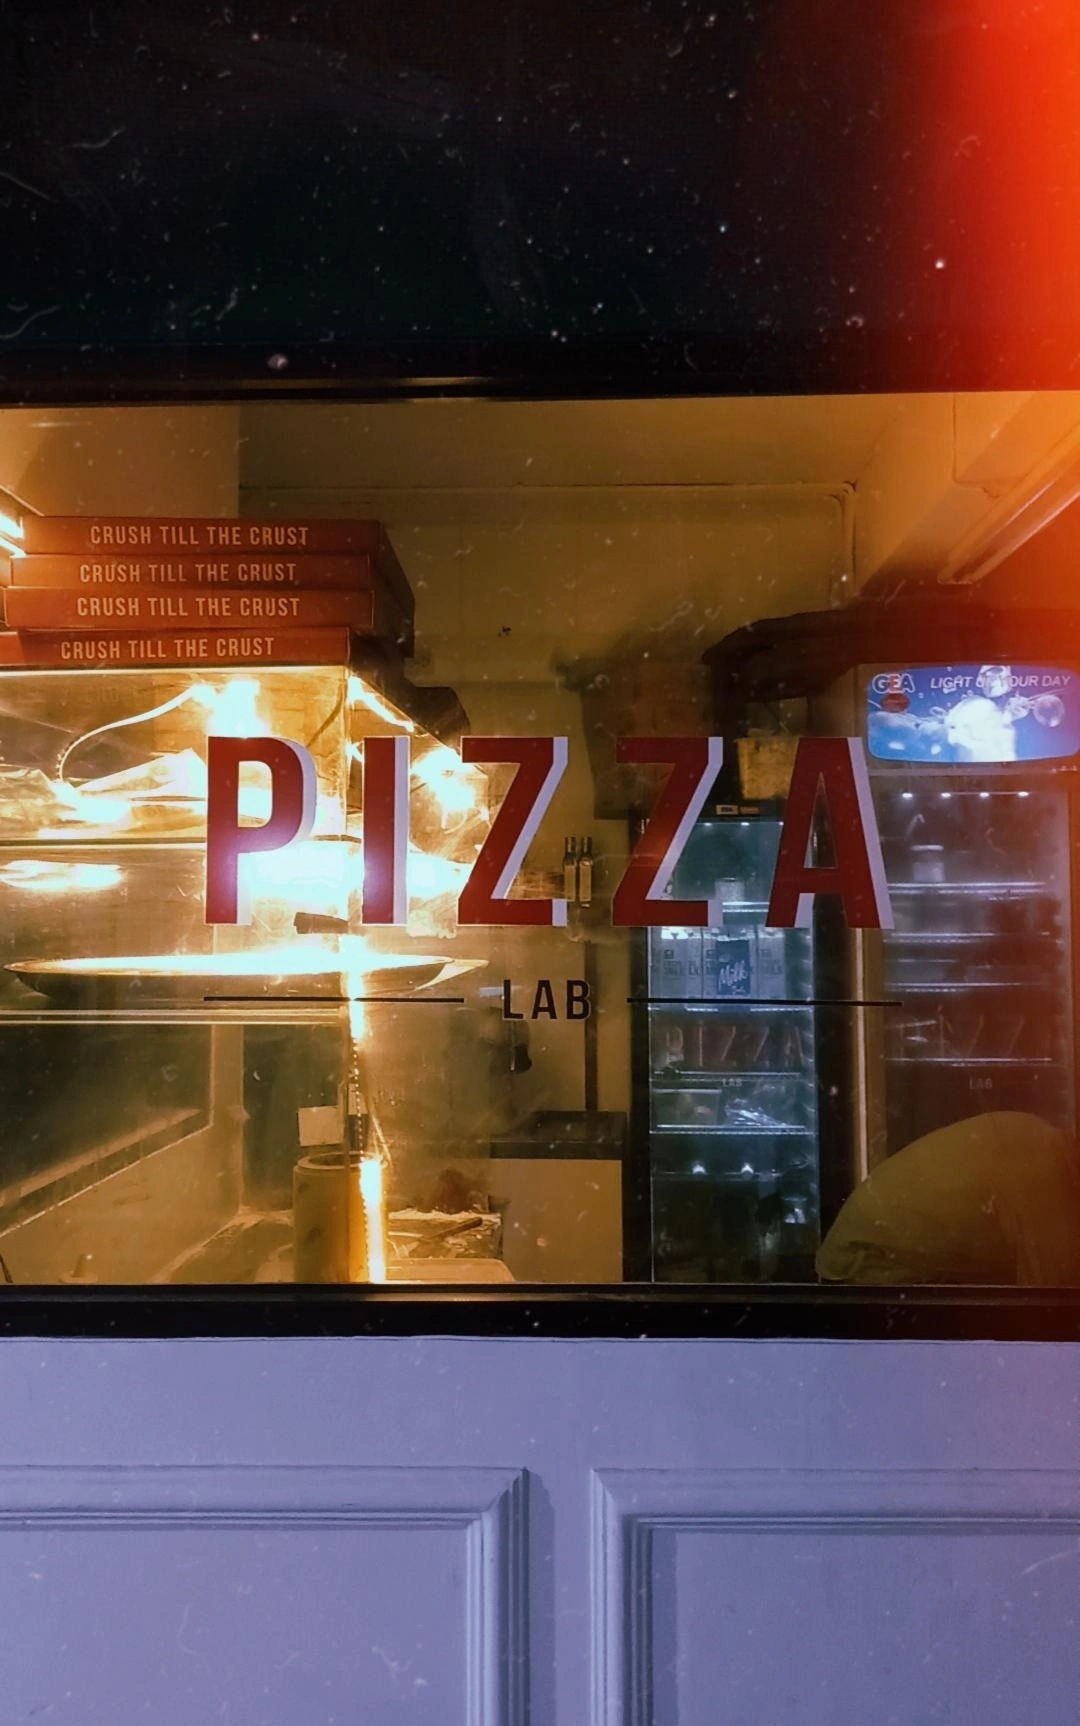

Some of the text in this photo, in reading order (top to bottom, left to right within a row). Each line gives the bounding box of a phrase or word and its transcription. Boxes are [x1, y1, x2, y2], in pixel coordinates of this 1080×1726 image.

[90, 525, 309, 547] CRUSH TILL THE CRUST
[79, 562, 297, 583] CRUSH TILL THE CRUST
[76, 597, 301, 617] CRUSH TILL THE CRUST
[60, 636, 275, 660] CRUSH TILL THE CRUST
[871, 673, 916, 694] GEA
[930, 676, 973, 689] LIGHT
[999, 675, 1039, 687] OUR
[1041, 675, 1071, 687] DAY
[205, 736, 894, 928] PIZZA
[502, 978, 591, 1020] LAB
